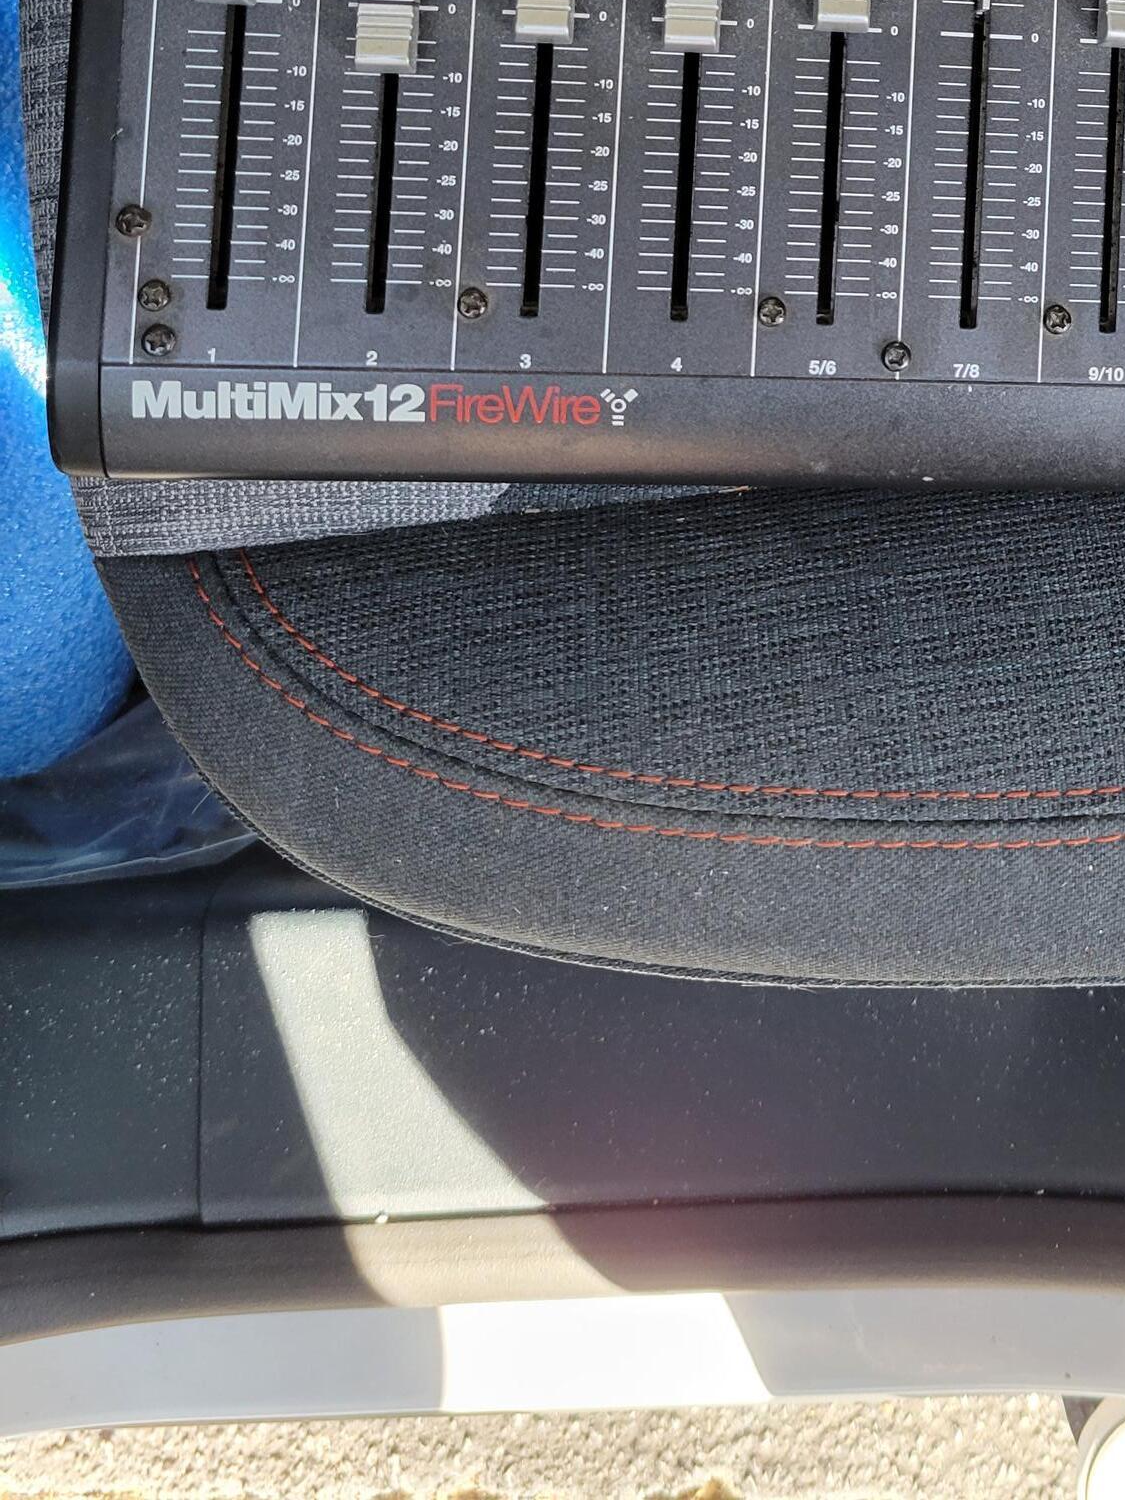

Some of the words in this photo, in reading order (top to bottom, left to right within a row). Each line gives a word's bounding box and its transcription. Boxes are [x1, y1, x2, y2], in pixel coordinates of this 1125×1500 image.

[287, 66, 306, 76] -10
[208, 348, 215, 363] 1
[366, 351, 377, 366] 2
[520, 354, 531, 368] 3
[671, 357, 682, 371] 4
[809, 360, 836, 375] 5/6
[954, 364, 979, 378] 7/8
[1089, 367, 1124, 381] 9/10
[132, 381, 425, 422] MultiMix12
[431, 385, 600, 424] FireWire
